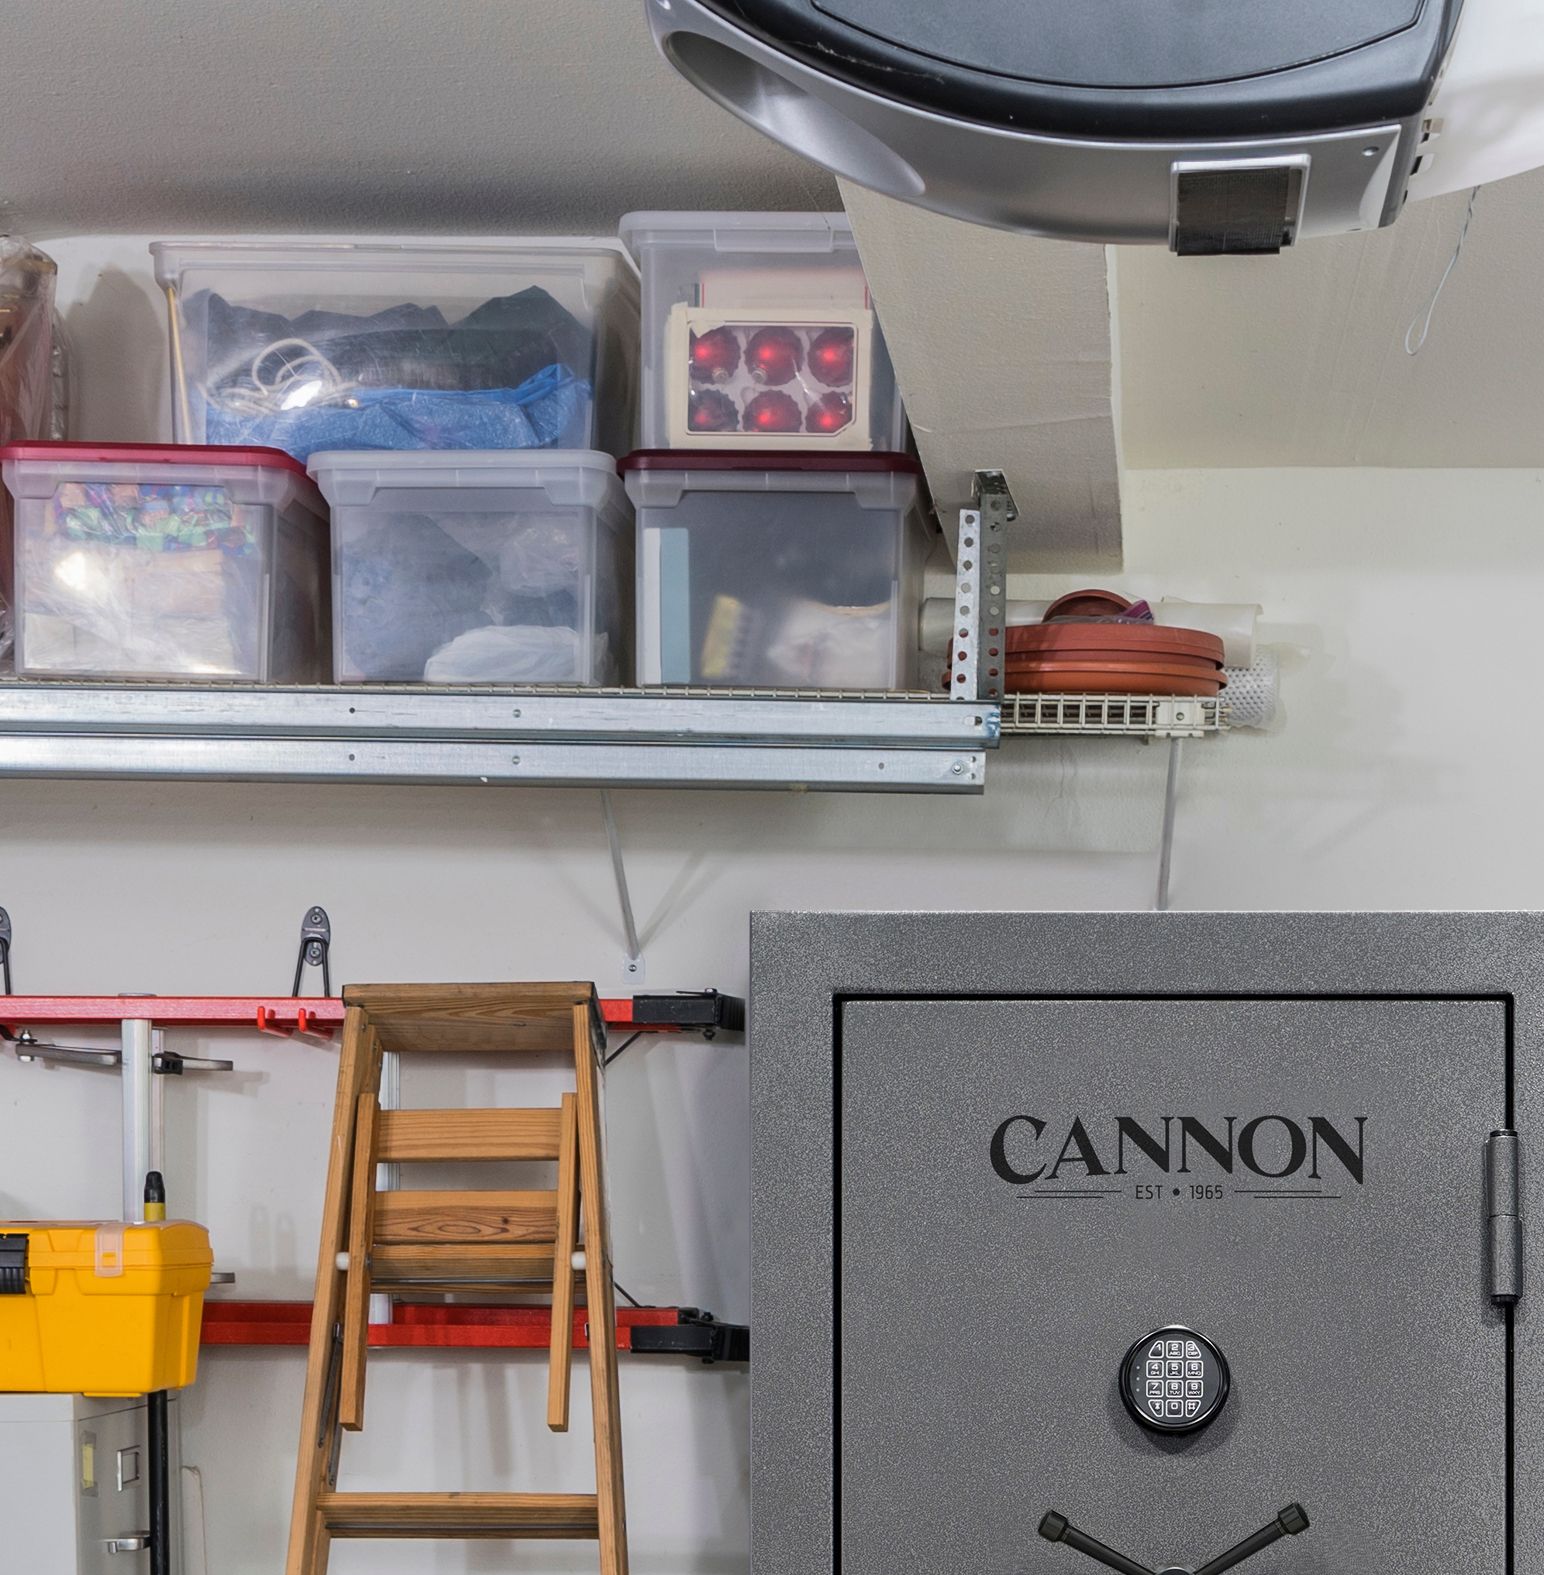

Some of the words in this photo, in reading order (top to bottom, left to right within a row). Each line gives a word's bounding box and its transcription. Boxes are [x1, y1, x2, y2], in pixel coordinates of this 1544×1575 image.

[989, 1115, 1368, 1185] CANNON
[1135, 1185, 1163, 1200] EST
[1189, 1185, 1223, 1200] 1965
[1156, 1343, 1161, 1351] 1
[1171, 1343, 1179, 1351] 2
[1187, 1343, 1195, 1351] 3
[1151, 1363, 1159, 1371] 4
[1171, 1363, 1179, 1371] 5
[1151, 1382, 1159, 1390] 7
[1171, 1382, 1179, 1390] 8
[1190, 1382, 1198, 1390] 9
[1171, 1402, 1179, 1410] 0
